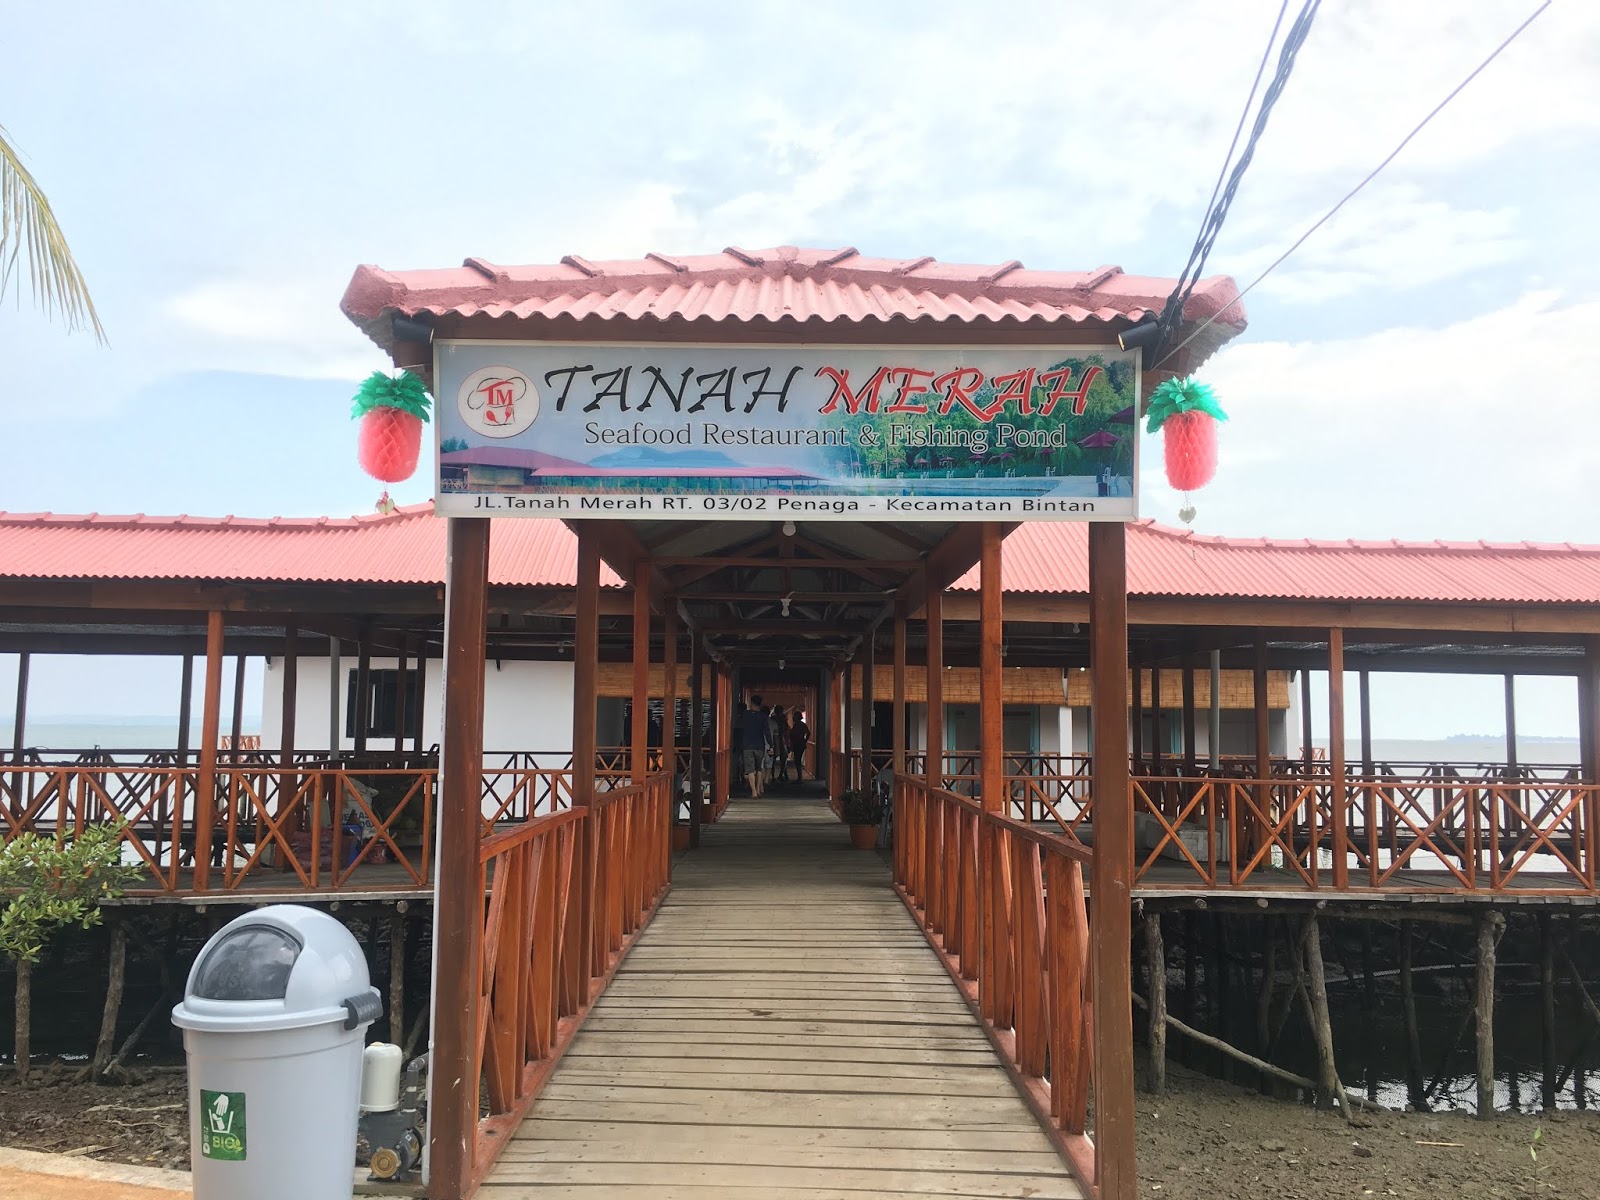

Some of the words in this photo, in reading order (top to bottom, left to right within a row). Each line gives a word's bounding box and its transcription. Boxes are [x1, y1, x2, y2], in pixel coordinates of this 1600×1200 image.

[544, 364, 804, 414] TANAH
[814, 365, 1103, 423] MERAH
[584, 421, 693, 446] Seafood
[703, 422, 849, 447] Restaurant
[858, 424, 879, 447] &
[889, 423, 989, 453] Fishing
[997, 423, 1067, 448] Pond
[580, 496, 652, 511] Merah
[663, 497, 693, 511] RT.
[703, 497, 767, 513] 03/02
[778, 498, 859, 514] Penaga
[886, 498, 1012, 512] Kecamatan
[1022, 498, 1095, 513] Bintan
